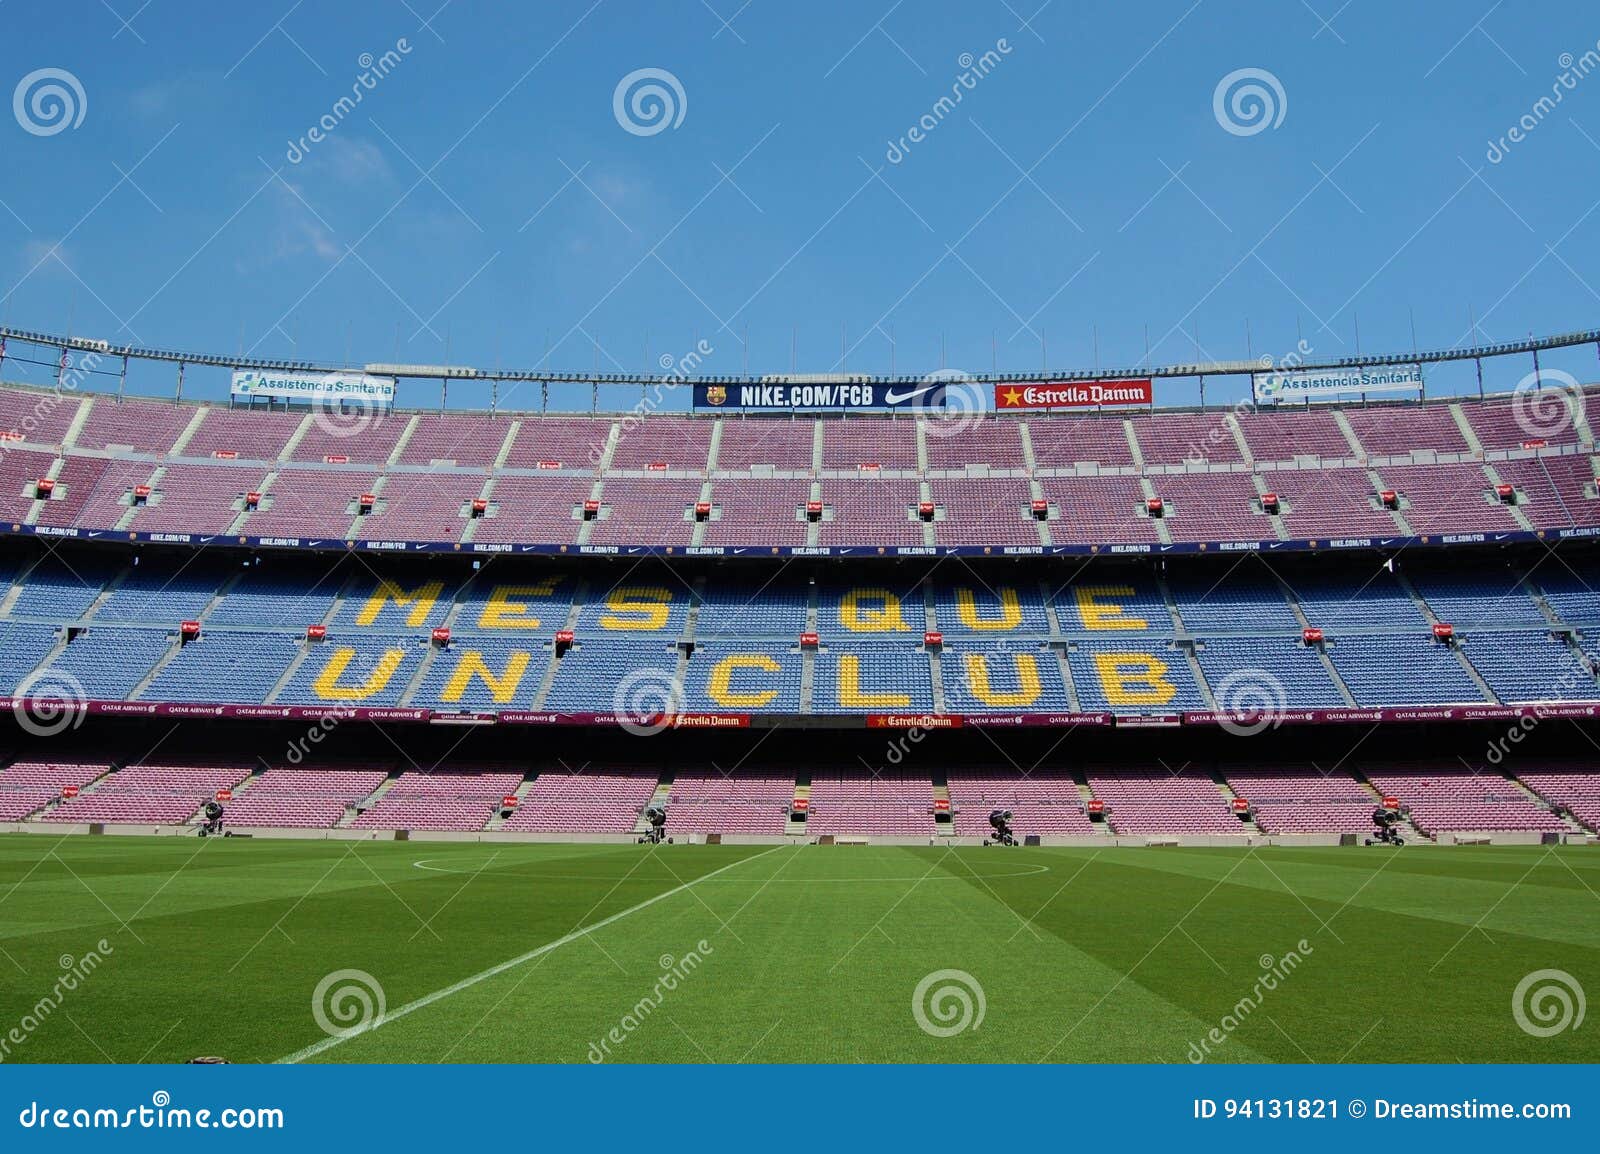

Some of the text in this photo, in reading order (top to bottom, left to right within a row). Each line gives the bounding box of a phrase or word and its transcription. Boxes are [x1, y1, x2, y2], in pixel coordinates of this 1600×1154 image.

[740, 385, 873, 407] NIKE.COM/FCB
[1023, 385, 1145, 404] Estrella Damm
[838, 584, 1148, 632] QUE
[313, 647, 1177, 707] UN CLUB
[711, 716, 740, 726] Damm
[887, 715, 922, 726] Estrella
